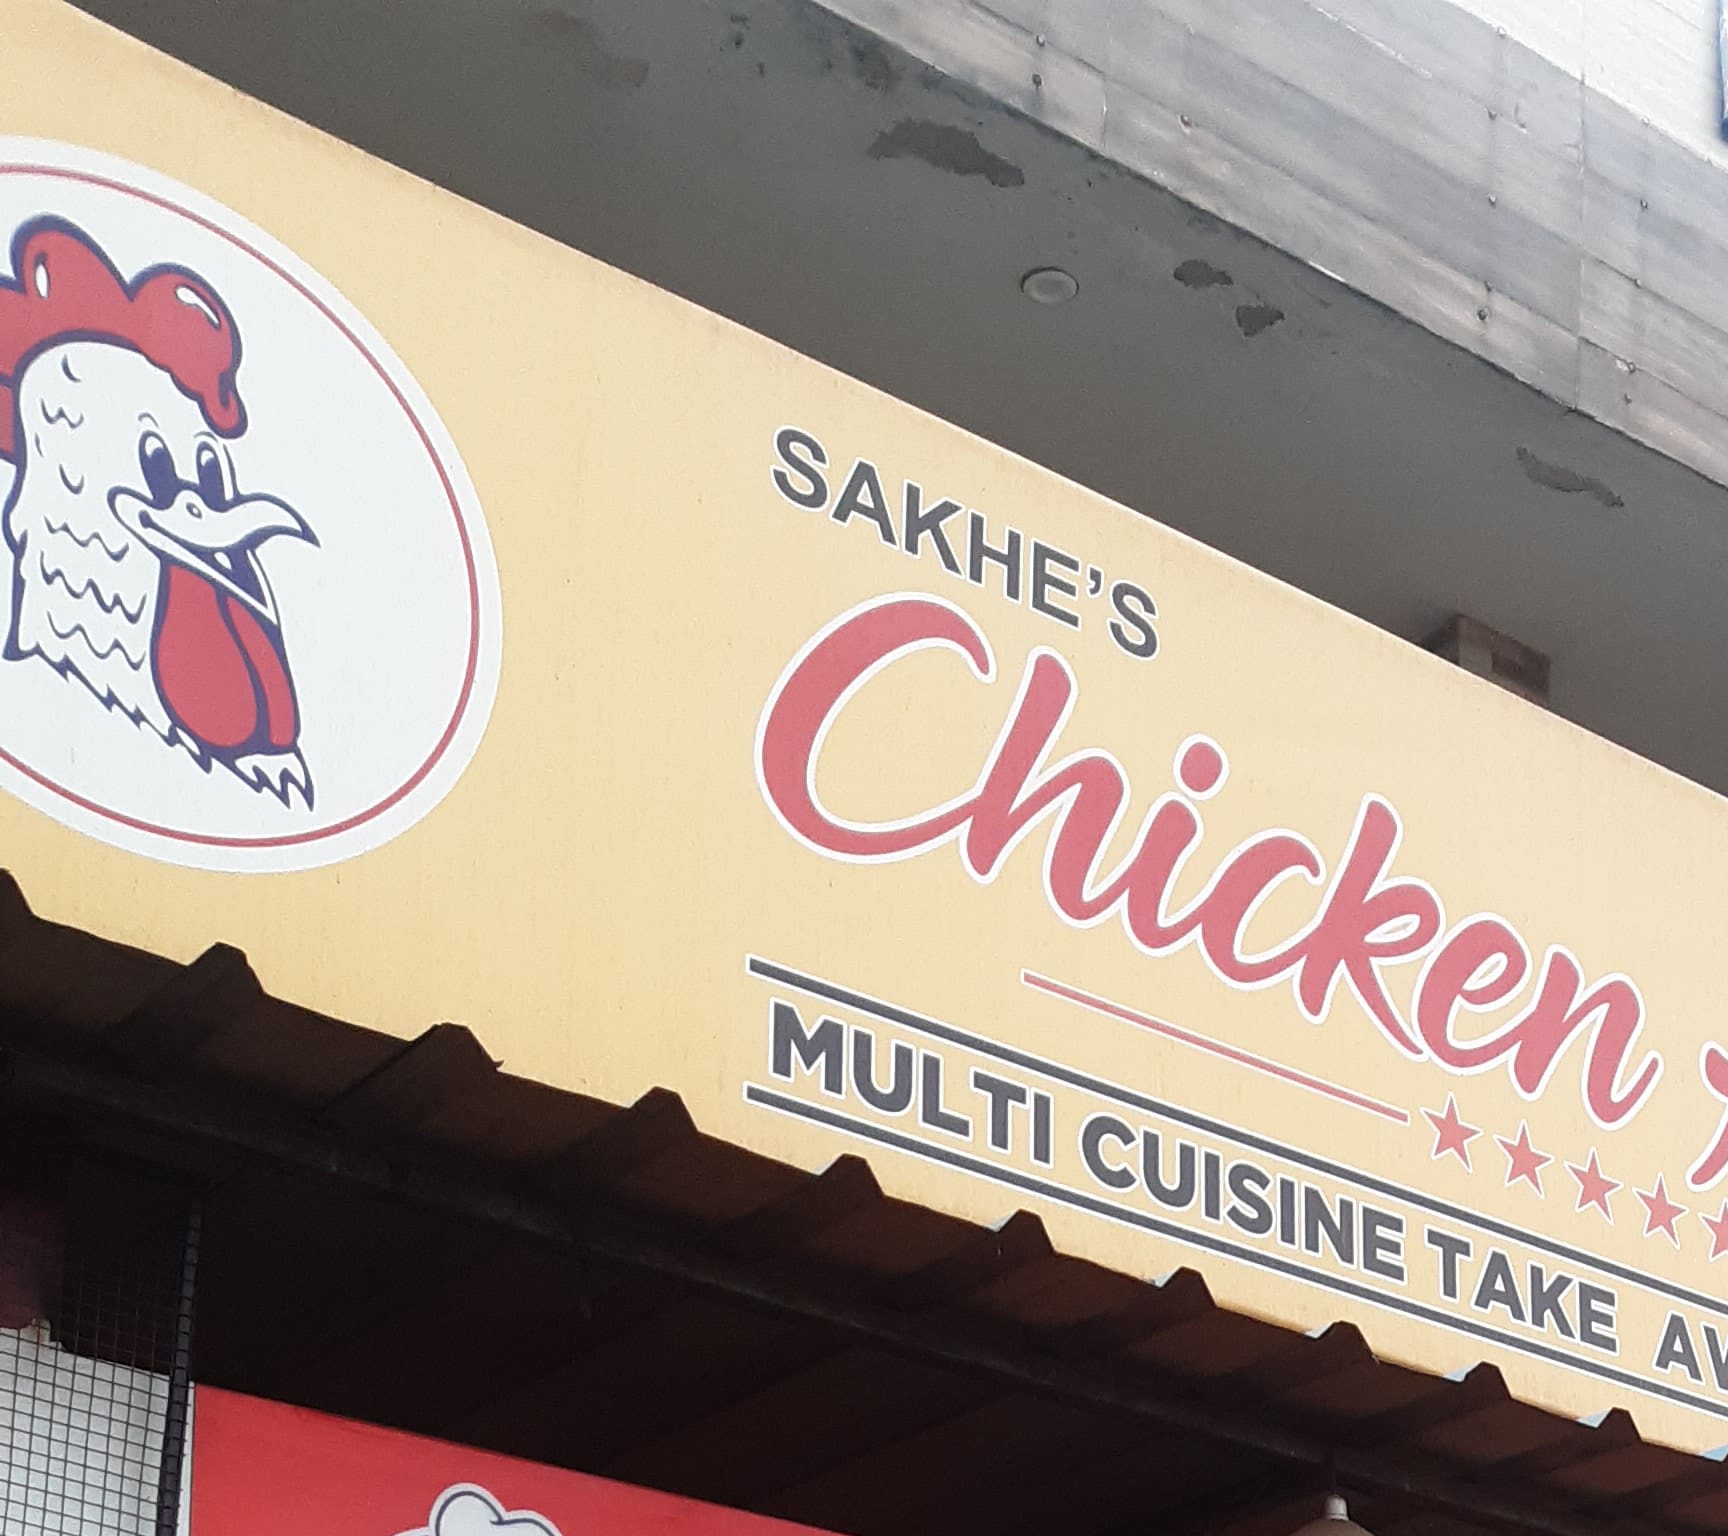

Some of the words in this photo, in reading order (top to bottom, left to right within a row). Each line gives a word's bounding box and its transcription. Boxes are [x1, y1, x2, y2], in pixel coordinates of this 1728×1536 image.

[757, 593, 1662, 1124] Chicken
[770, 1000, 1053, 1166] MULTI
[1079, 1114, 1406, 1282] CUISINE
[1427, 1228, 1619, 1354] TAKE
